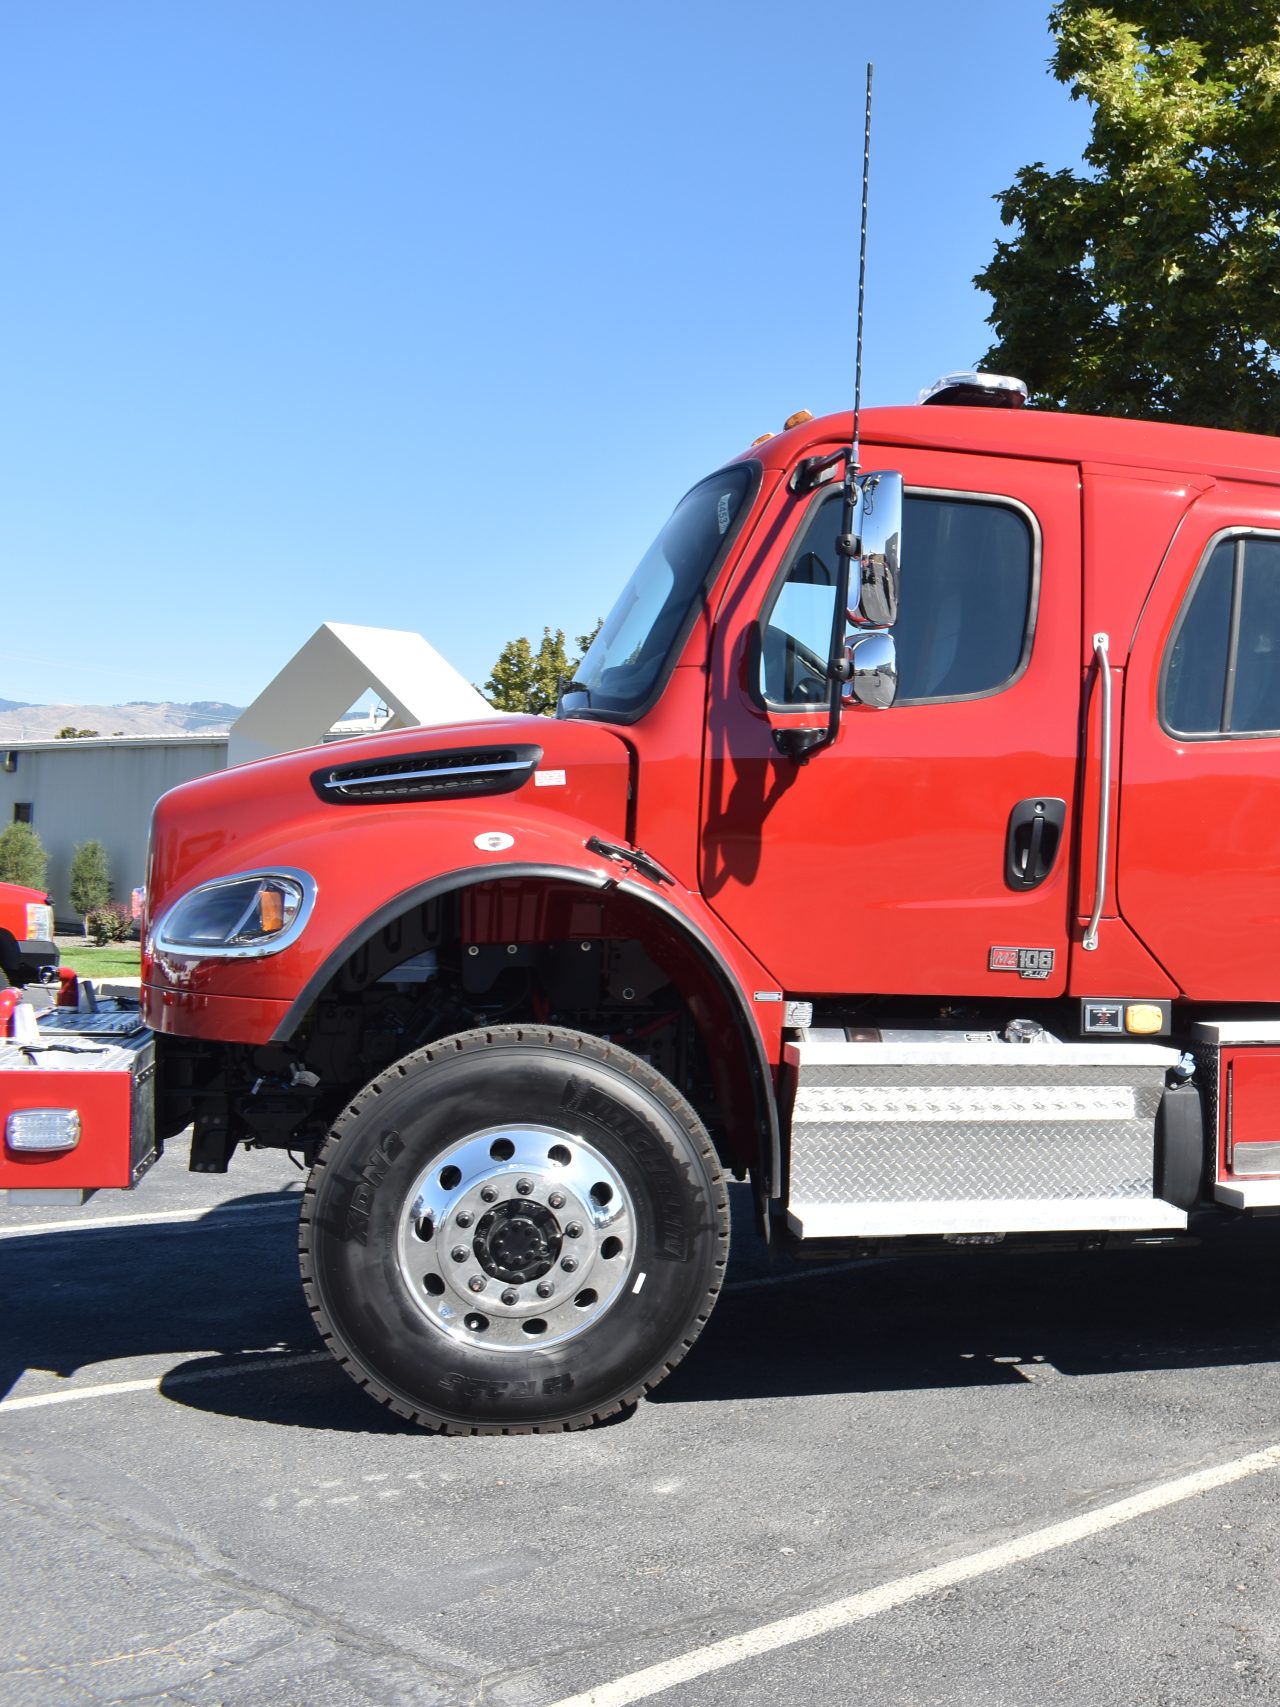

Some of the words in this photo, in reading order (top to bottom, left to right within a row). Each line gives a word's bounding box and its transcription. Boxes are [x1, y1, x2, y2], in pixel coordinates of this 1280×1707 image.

[995, 951, 1017, 966] M2
[1019, 950, 1052, 969] 106
[588, 1095, 685, 1256] MICHELIN
